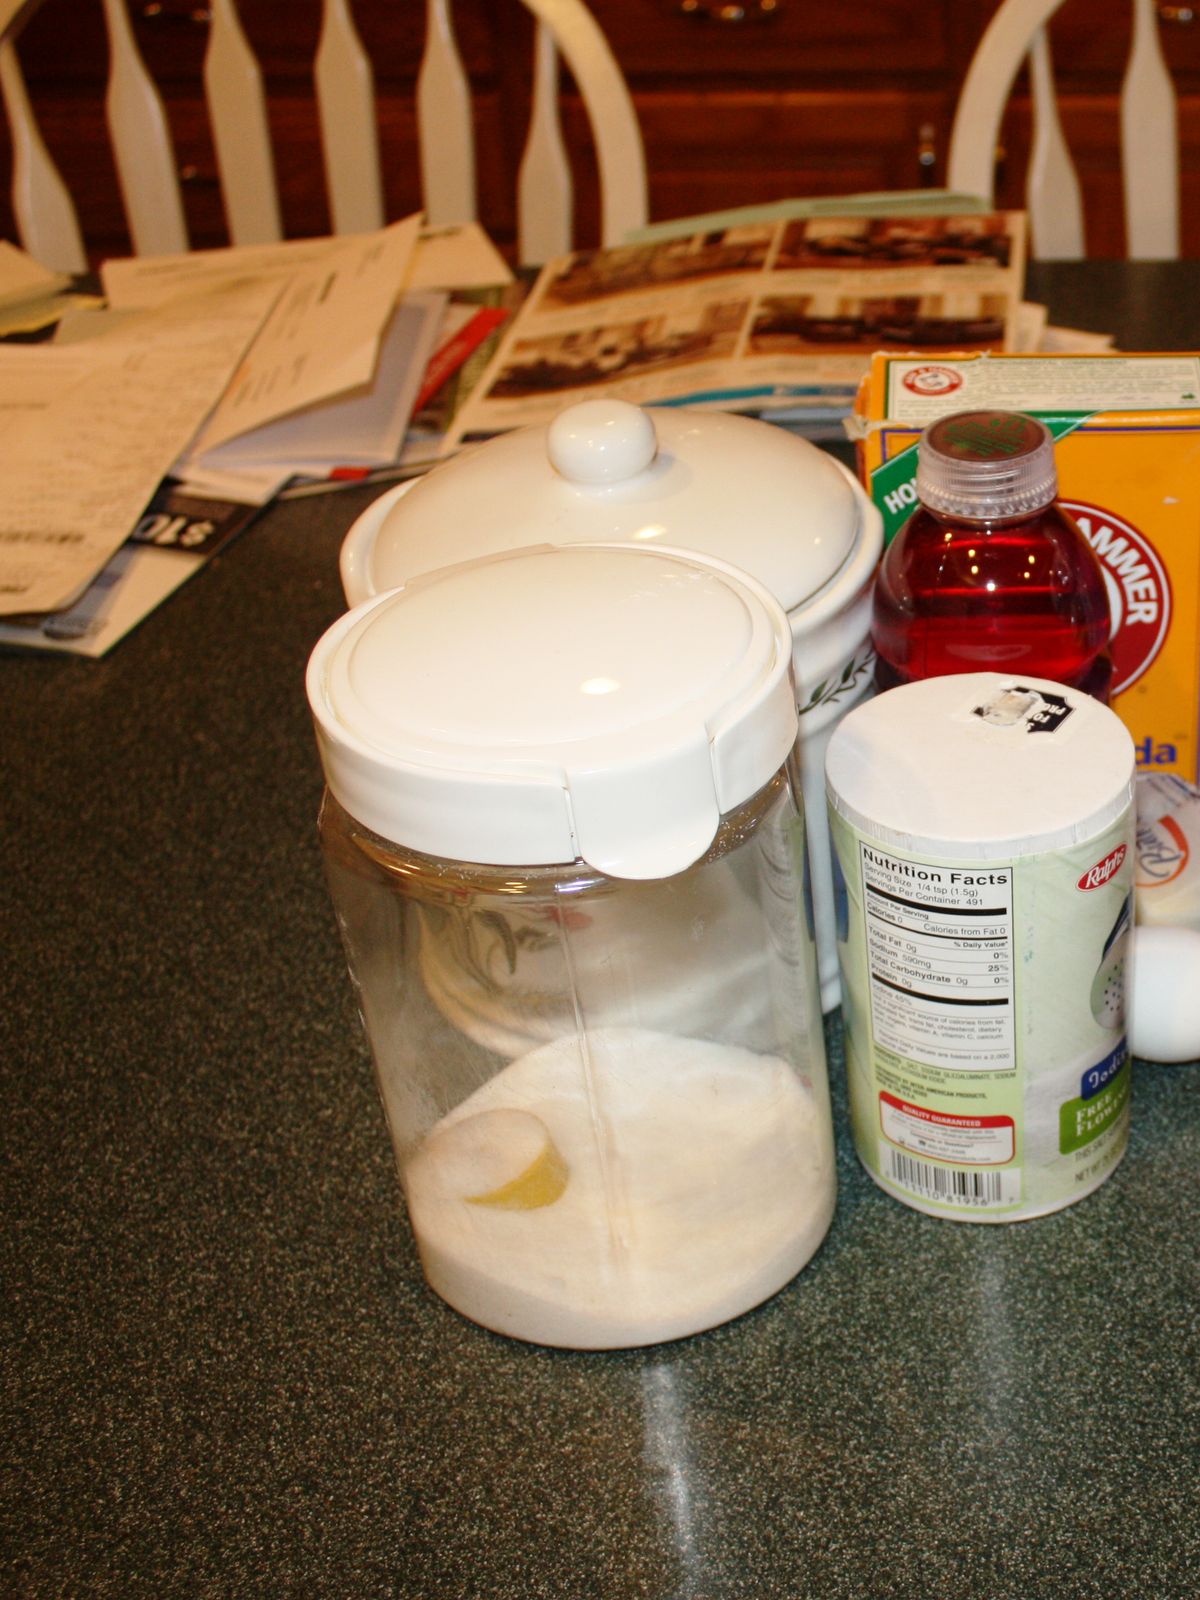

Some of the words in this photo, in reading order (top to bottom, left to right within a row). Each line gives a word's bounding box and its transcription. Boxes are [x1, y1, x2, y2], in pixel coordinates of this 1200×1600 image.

[883, 479, 918, 514] HO
[863, 848, 941, 883] Nutrition
[951, 873, 1008, 886] Facts
[864, 862, 891, 882] Serving
[894, 875, 912, 887] Size
[917, 882, 931, 892] 1/4
[933, 886, 948, 895] tsp
[950, 887, 979, 898] (1.5g)
[1085, 848, 1125, 889] Ralphs
[864, 872, 897, 893] Servings
[899, 887, 913, 897] Per
[915, 892, 961, 905] Container
[966, 898, 983, 906] 491
[902, 906, 929, 920] Serving
[923, 923, 959, 935] Calories
[960, 928, 981, 936] from
[983, 927, 998, 935] Fat
[962, 941, 982, 949] Daily
[889, 960, 951, 983] Carbohydrate
[931, 1114, 982, 1127] GUARANTEED
[1076, 1092, 1112, 1122] FREE
